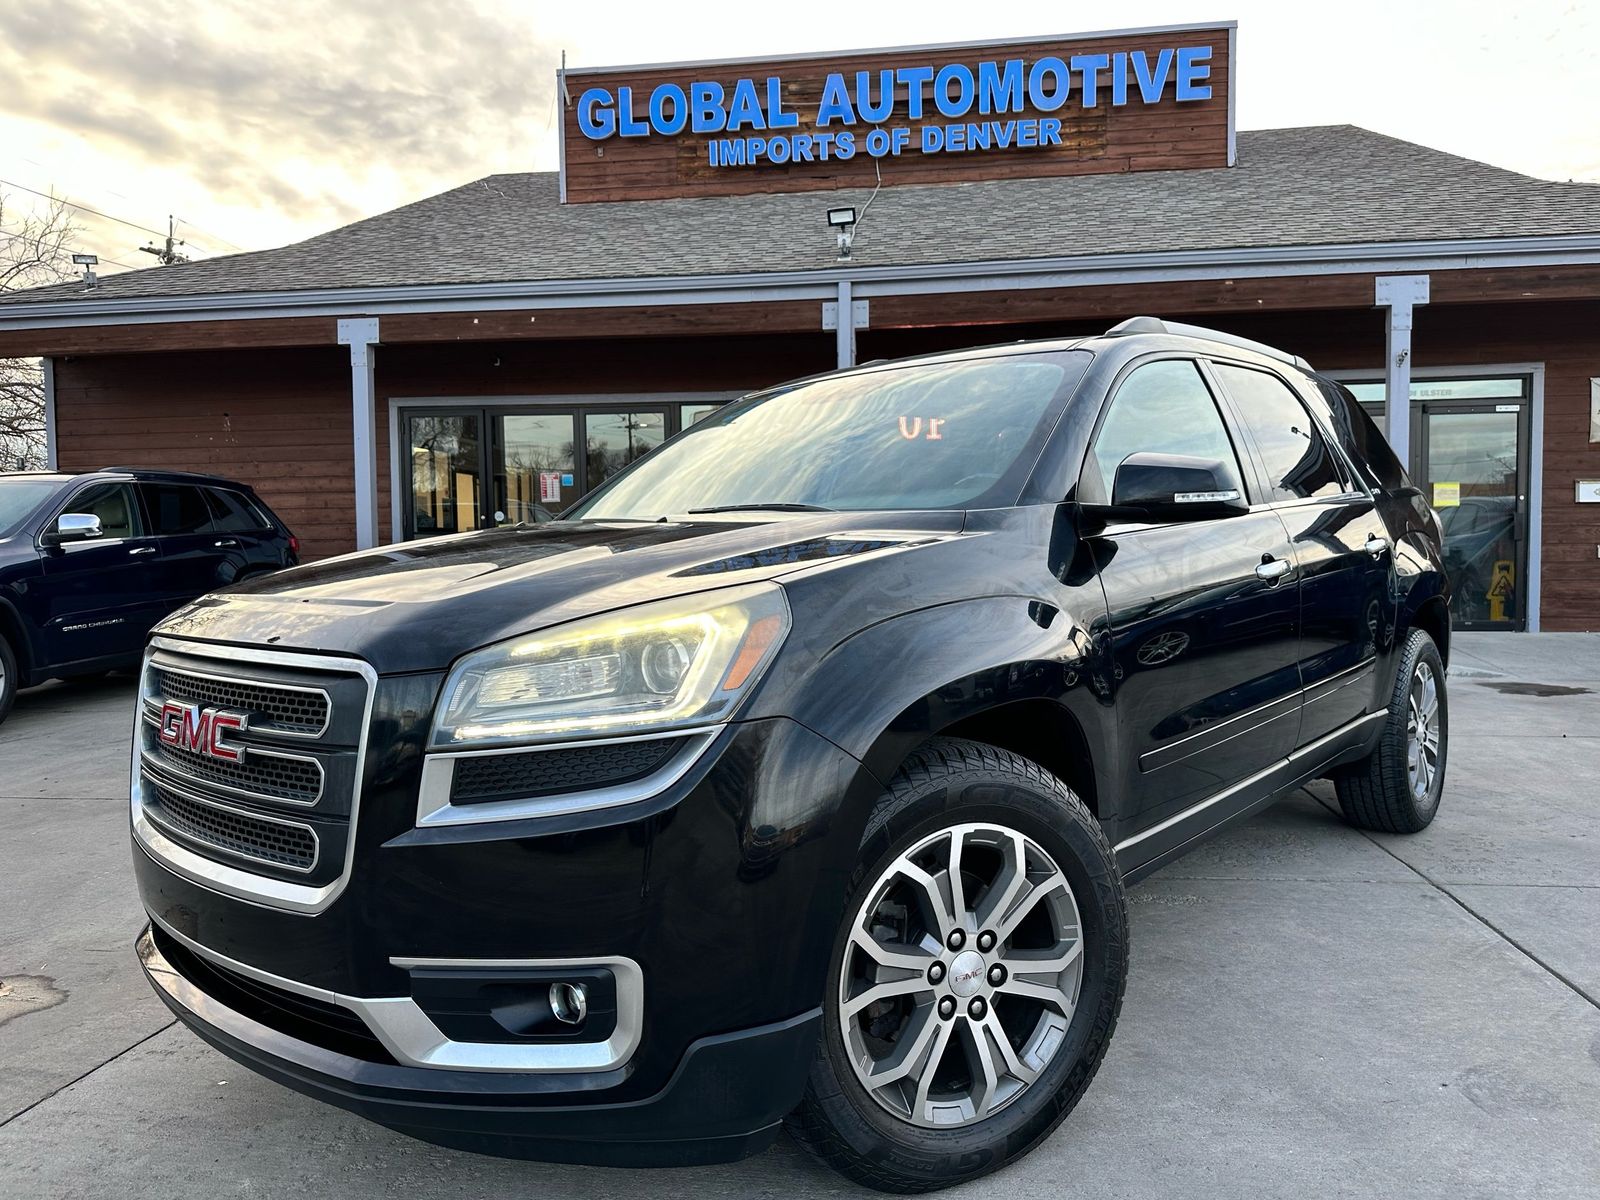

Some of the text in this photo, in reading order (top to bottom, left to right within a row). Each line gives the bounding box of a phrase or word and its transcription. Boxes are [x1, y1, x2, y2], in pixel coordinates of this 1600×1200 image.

[577, 46, 1213, 140] GLOBAL AUTOMOTIVE
[708, 118, 1063, 167] IMPORTS OF DENVER
[1420, 389, 1452, 397] ULSTER
[160, 699, 249, 764] GMC
[954, 967, 983, 982] GMC
